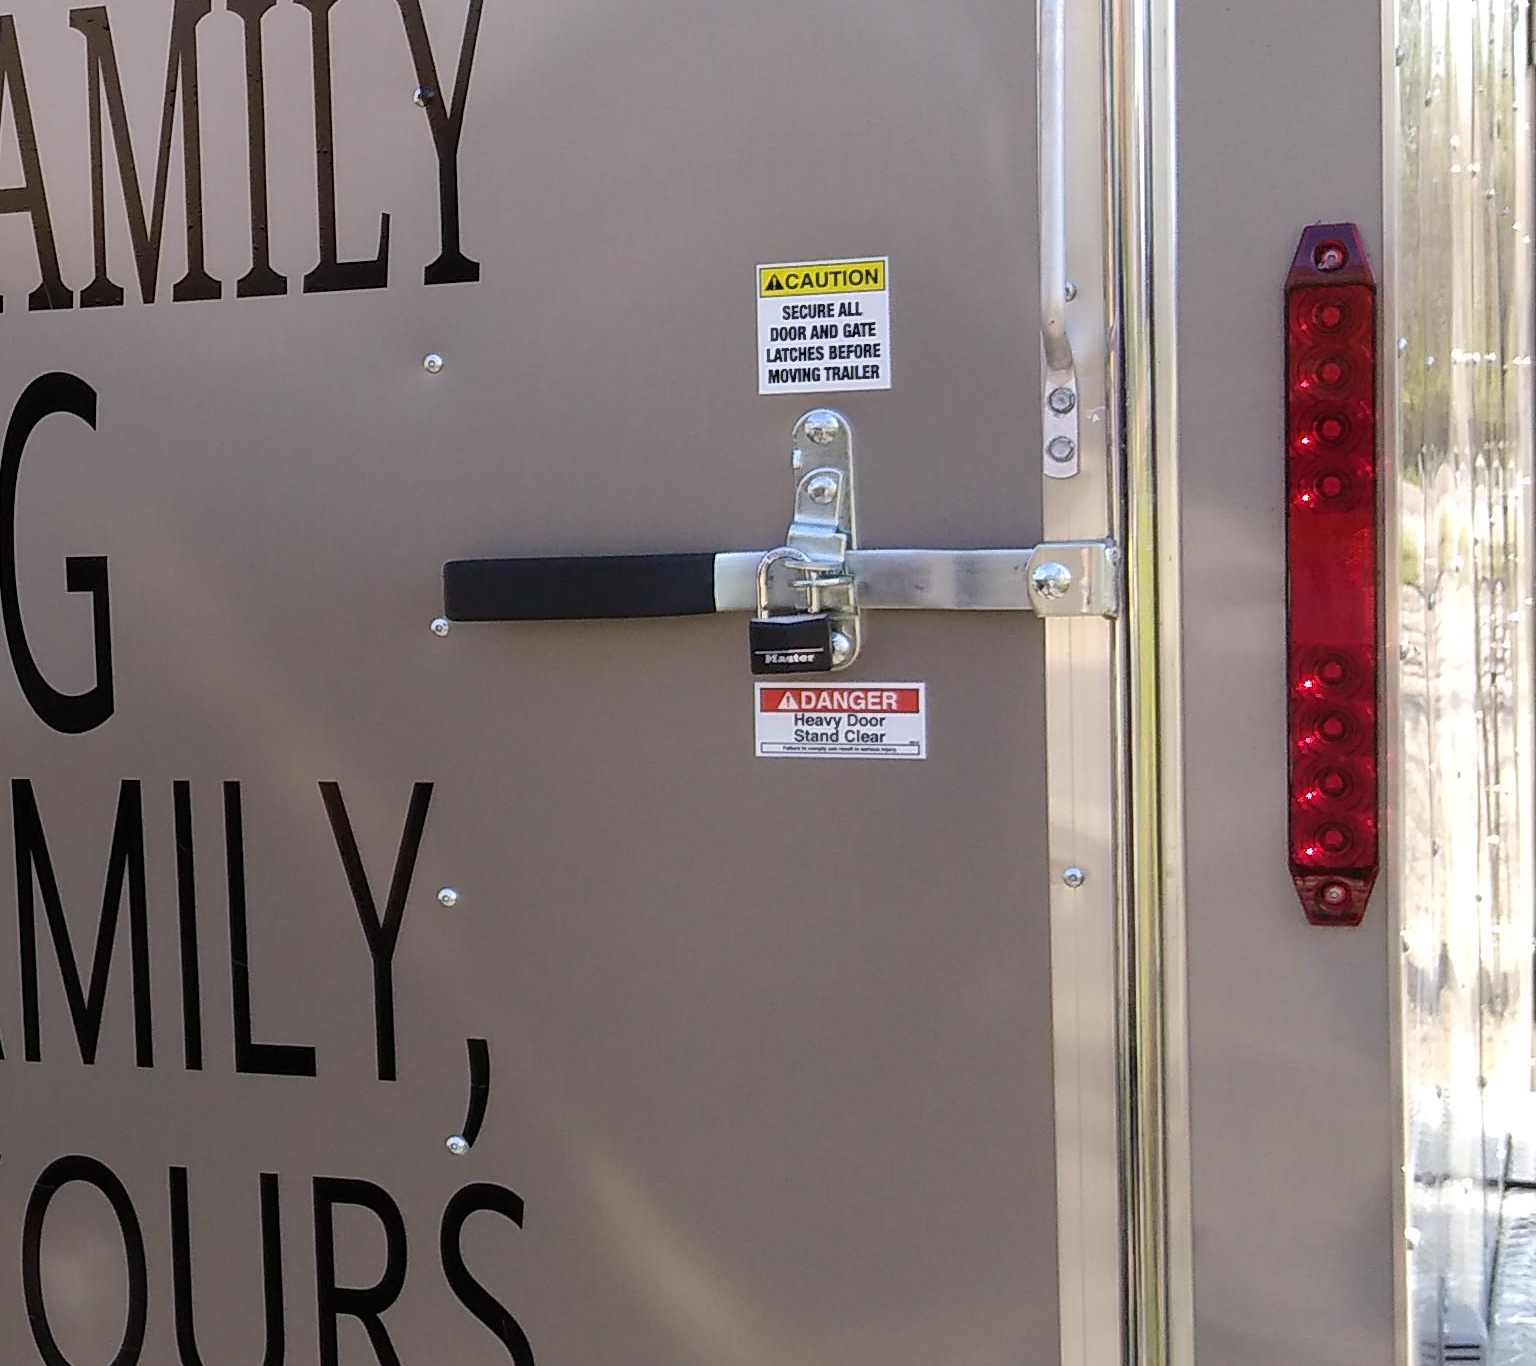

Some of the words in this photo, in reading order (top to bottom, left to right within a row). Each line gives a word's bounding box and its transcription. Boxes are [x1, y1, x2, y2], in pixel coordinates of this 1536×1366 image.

[785, 268, 879, 290] CAUTION
[782, 302, 835, 320] SECURE
[837, 301, 863, 317] ALL
[770, 326, 806, 342] DOOR
[810, 324, 838, 339] AND
[843, 322, 876, 338] GATE
[766, 346, 824, 363] LATCHES
[829, 343, 880, 360] BEFORE
[768, 367, 820, 384] MOVING
[824, 364, 880, 381] TRAILER
[765, 653, 814, 664] Master
[801, 691, 898, 710] DANGER
[794, 713, 842, 729] Heavy
[847, 714, 886, 727] Door
[794, 729, 839, 743] Stand
[844, 729, 886, 743] Clear
